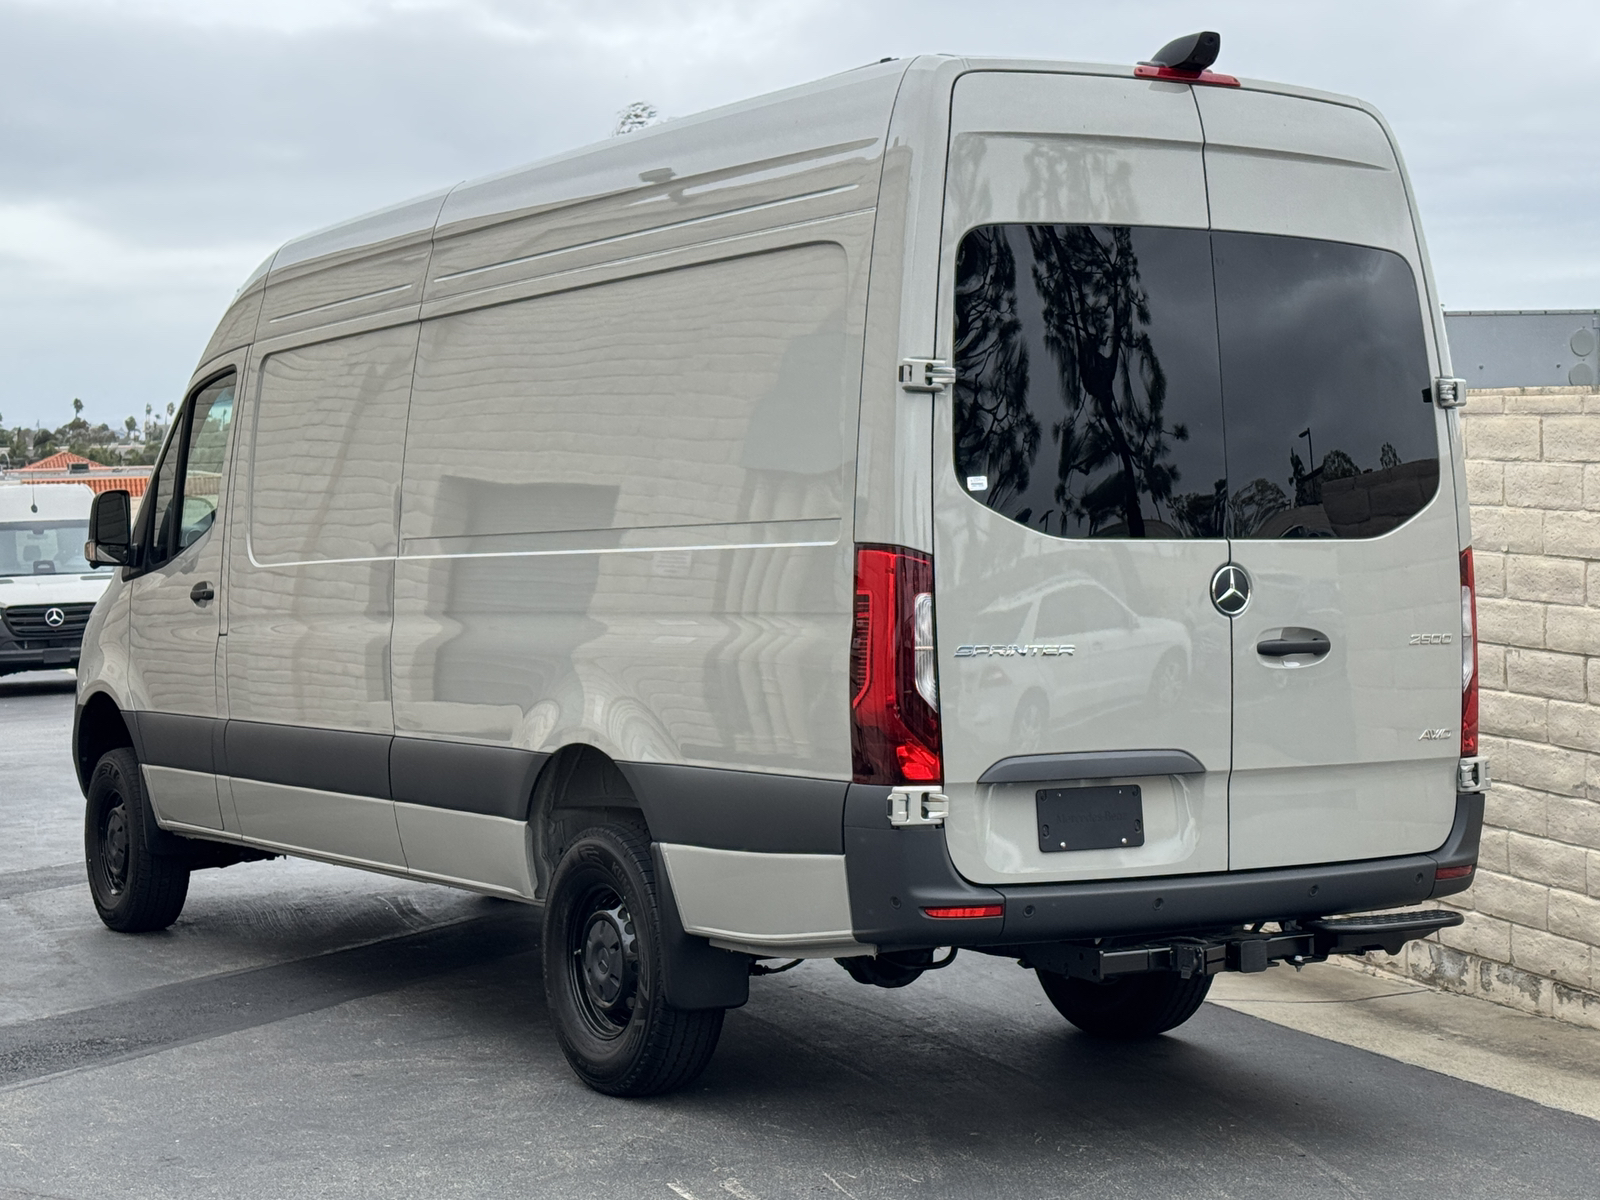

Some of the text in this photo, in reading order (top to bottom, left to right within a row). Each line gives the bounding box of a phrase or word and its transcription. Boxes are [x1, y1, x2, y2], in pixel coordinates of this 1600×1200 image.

[1409, 633, 1452, 646] 2500
[954, 644, 1076, 658] SPRINTER
[1418, 728, 1452, 741] AWD
